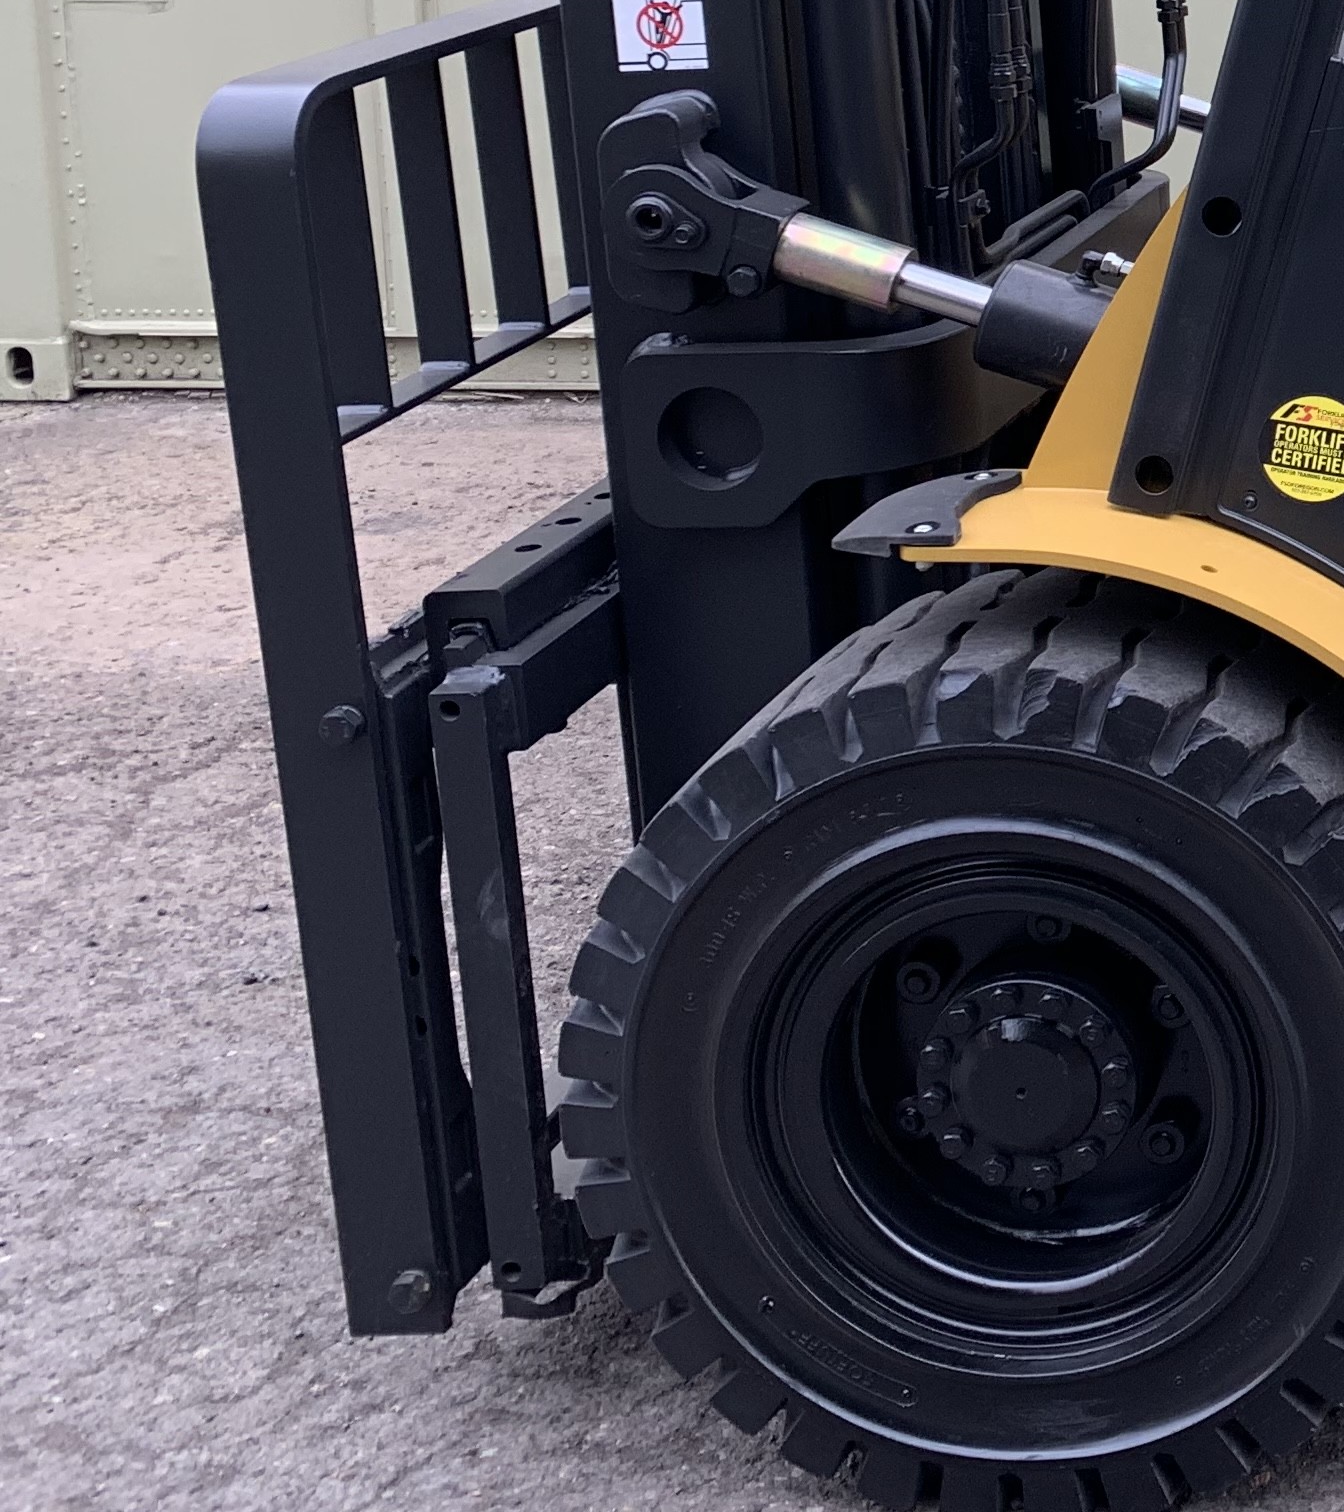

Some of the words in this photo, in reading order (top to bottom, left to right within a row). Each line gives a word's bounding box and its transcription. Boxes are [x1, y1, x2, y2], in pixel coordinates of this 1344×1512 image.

[1273, 439, 1319, 454] OPERATORS
[1320, 446, 1343, 458] MUST
[1270, 466, 1296, 476] OPERATOR
[1297, 471, 1321, 480] TRAINING
